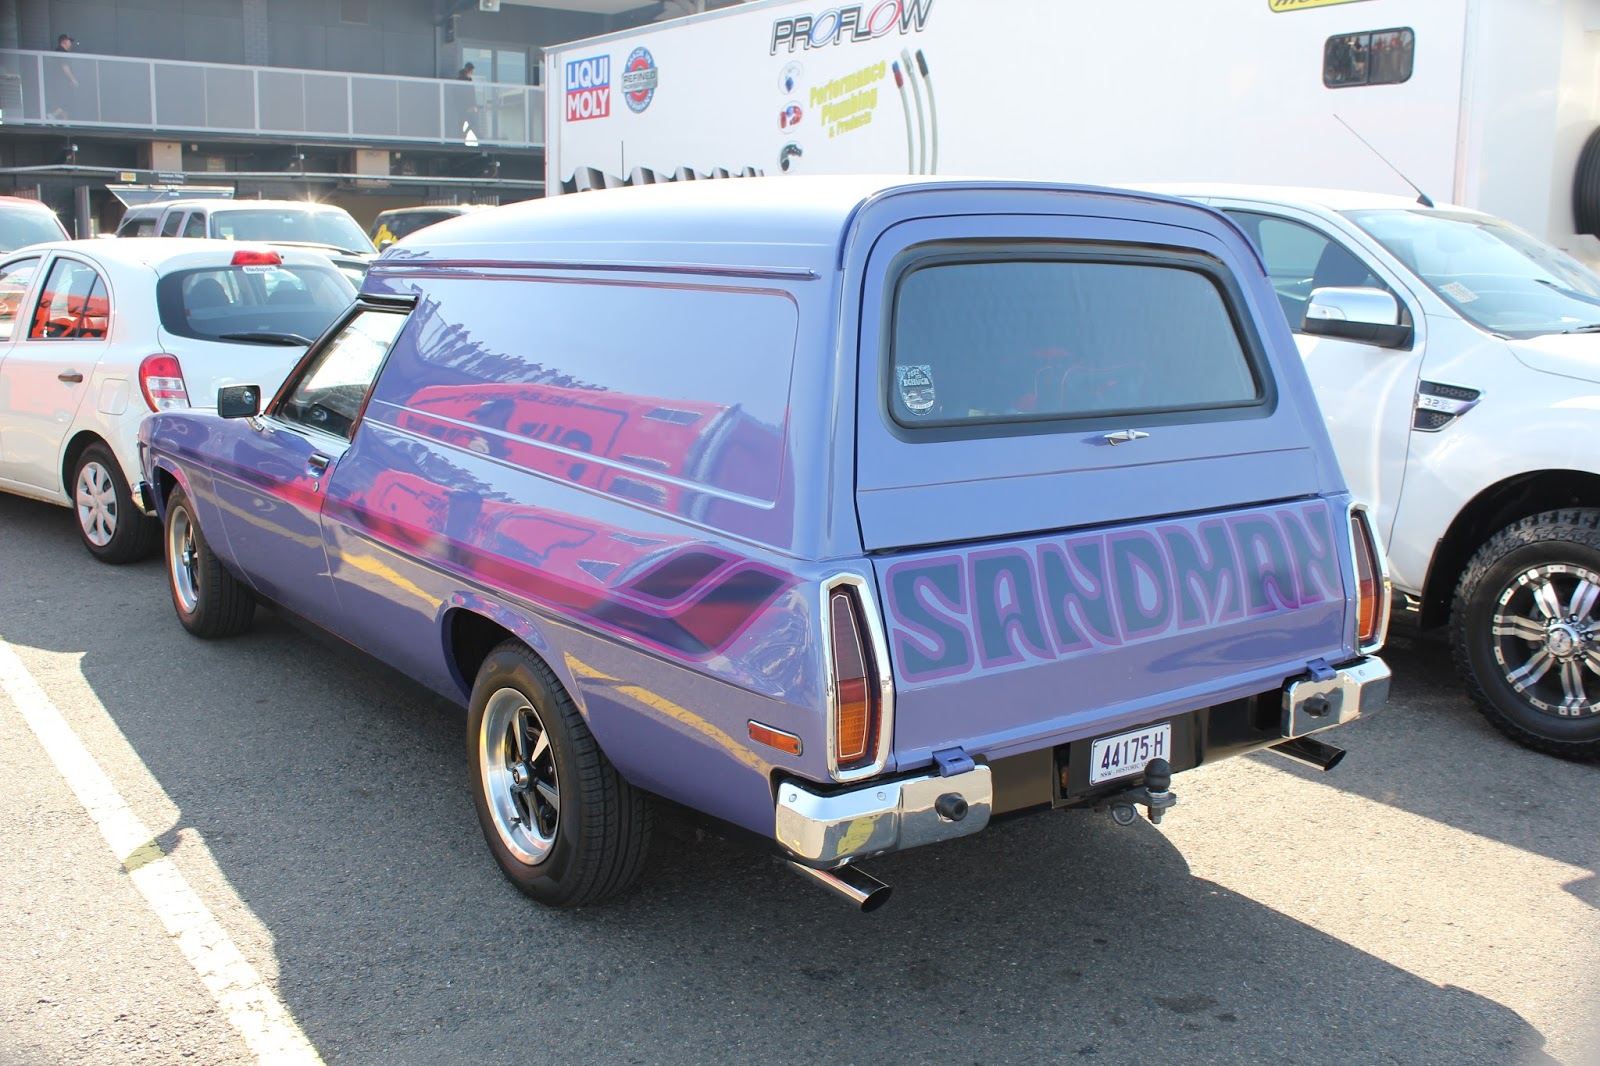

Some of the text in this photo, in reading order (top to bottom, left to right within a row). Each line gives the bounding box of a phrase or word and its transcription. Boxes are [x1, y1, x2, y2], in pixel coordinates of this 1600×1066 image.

[770, 0, 933, 55] PROFLOW
[567, 57, 609, 91] LIQUI
[624, 71, 656, 83] REFINED
[567, 88, 609, 120] MOLY
[885, 504, 1344, 683] SANDMAN
[1100, 769, 1112, 778] NSW
[1115, 763, 1141, 774] HISTORIC
